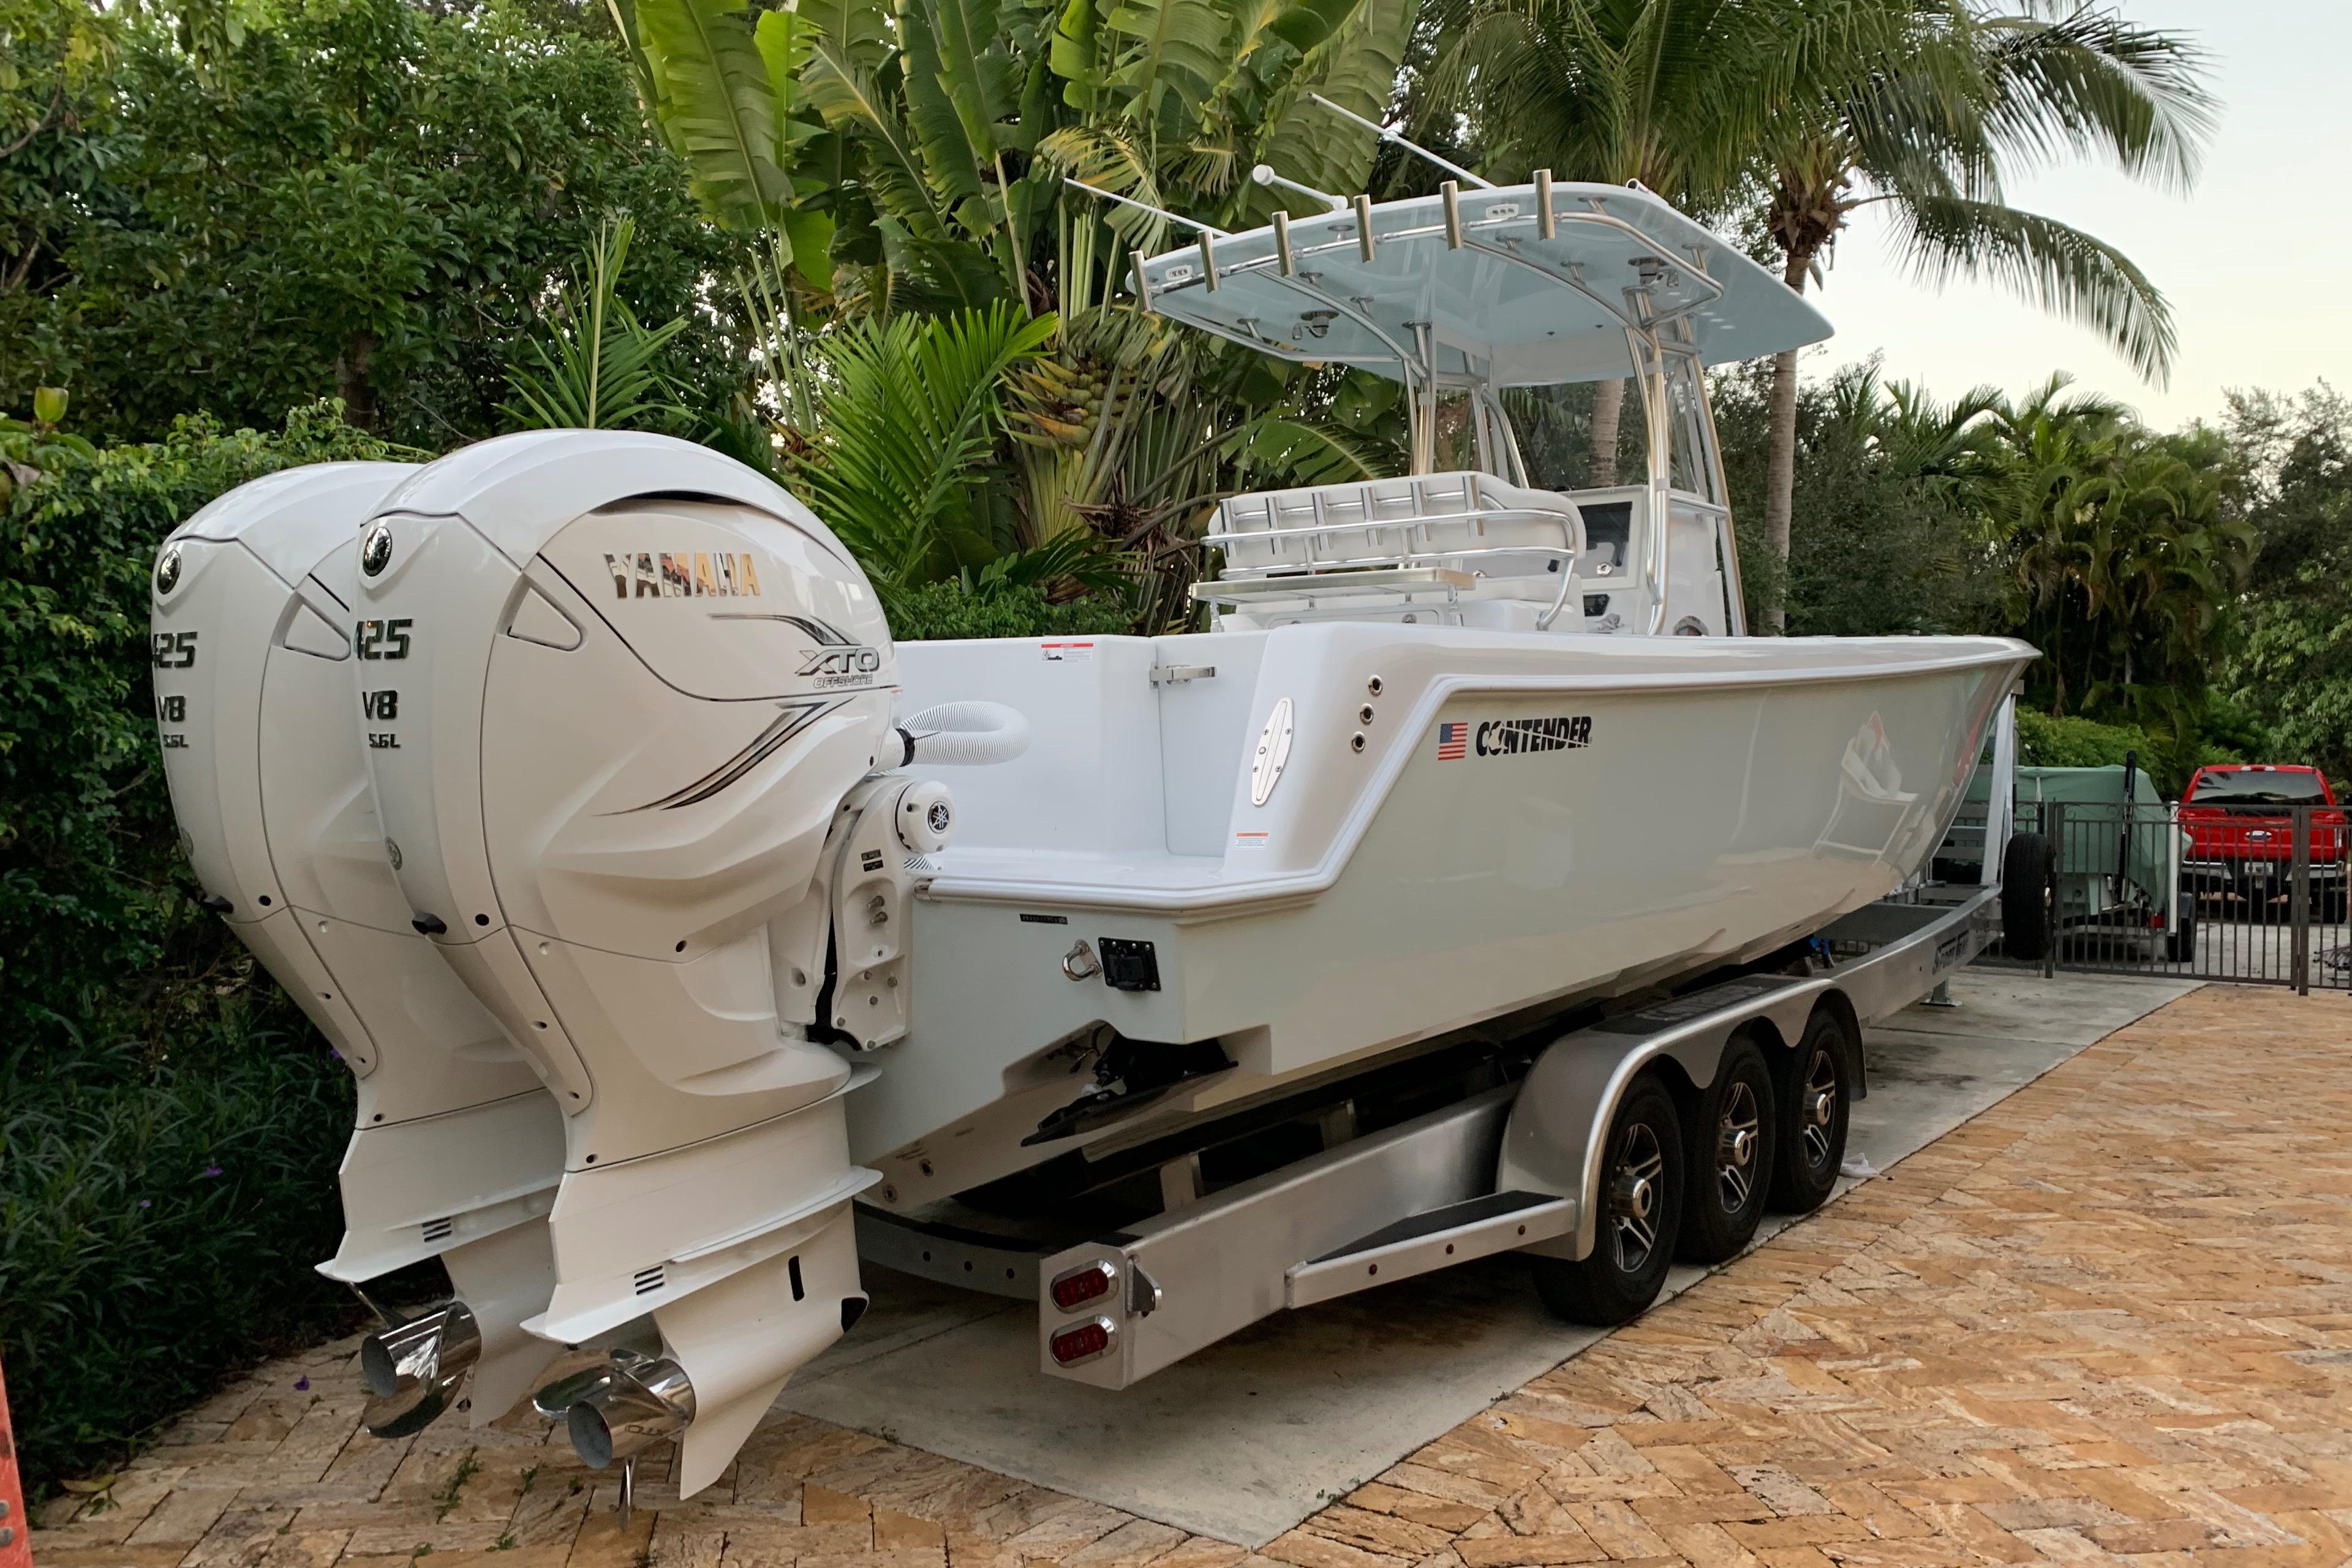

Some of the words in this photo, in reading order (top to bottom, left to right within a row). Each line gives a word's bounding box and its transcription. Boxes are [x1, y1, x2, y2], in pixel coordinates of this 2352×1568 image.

[603, 552, 760, 598] YAMAHA
[794, 647, 880, 676] XTO
[813, 674, 873, 688] OFFSHORE
[157, 695, 186, 722] V8
[362, 690, 398, 720] V8
[1476, 716, 1592, 756] CONTENDER
